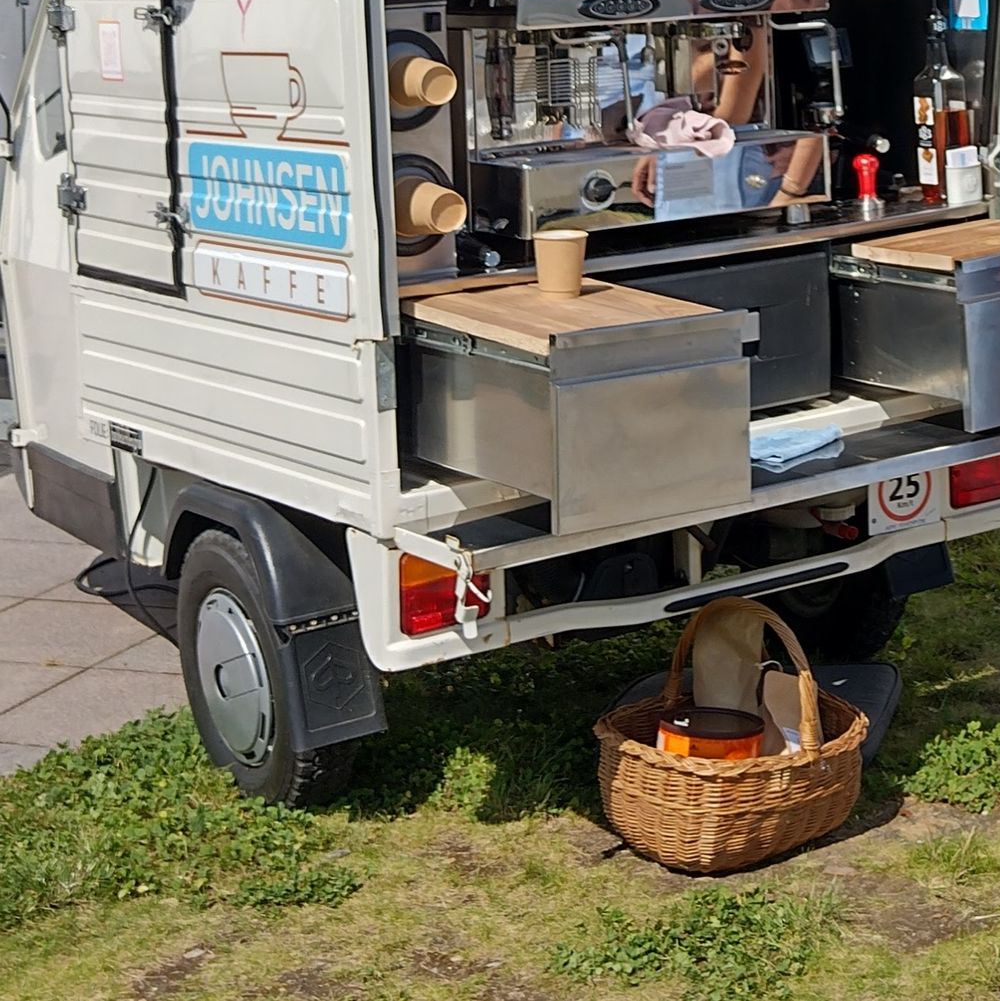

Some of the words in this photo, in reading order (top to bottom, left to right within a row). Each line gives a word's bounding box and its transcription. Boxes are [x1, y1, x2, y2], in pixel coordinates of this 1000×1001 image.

[195, 154, 342, 237] JOHNSEN
[210, 256, 326, 304] KAFFE
[888, 472, 920, 502] 25
